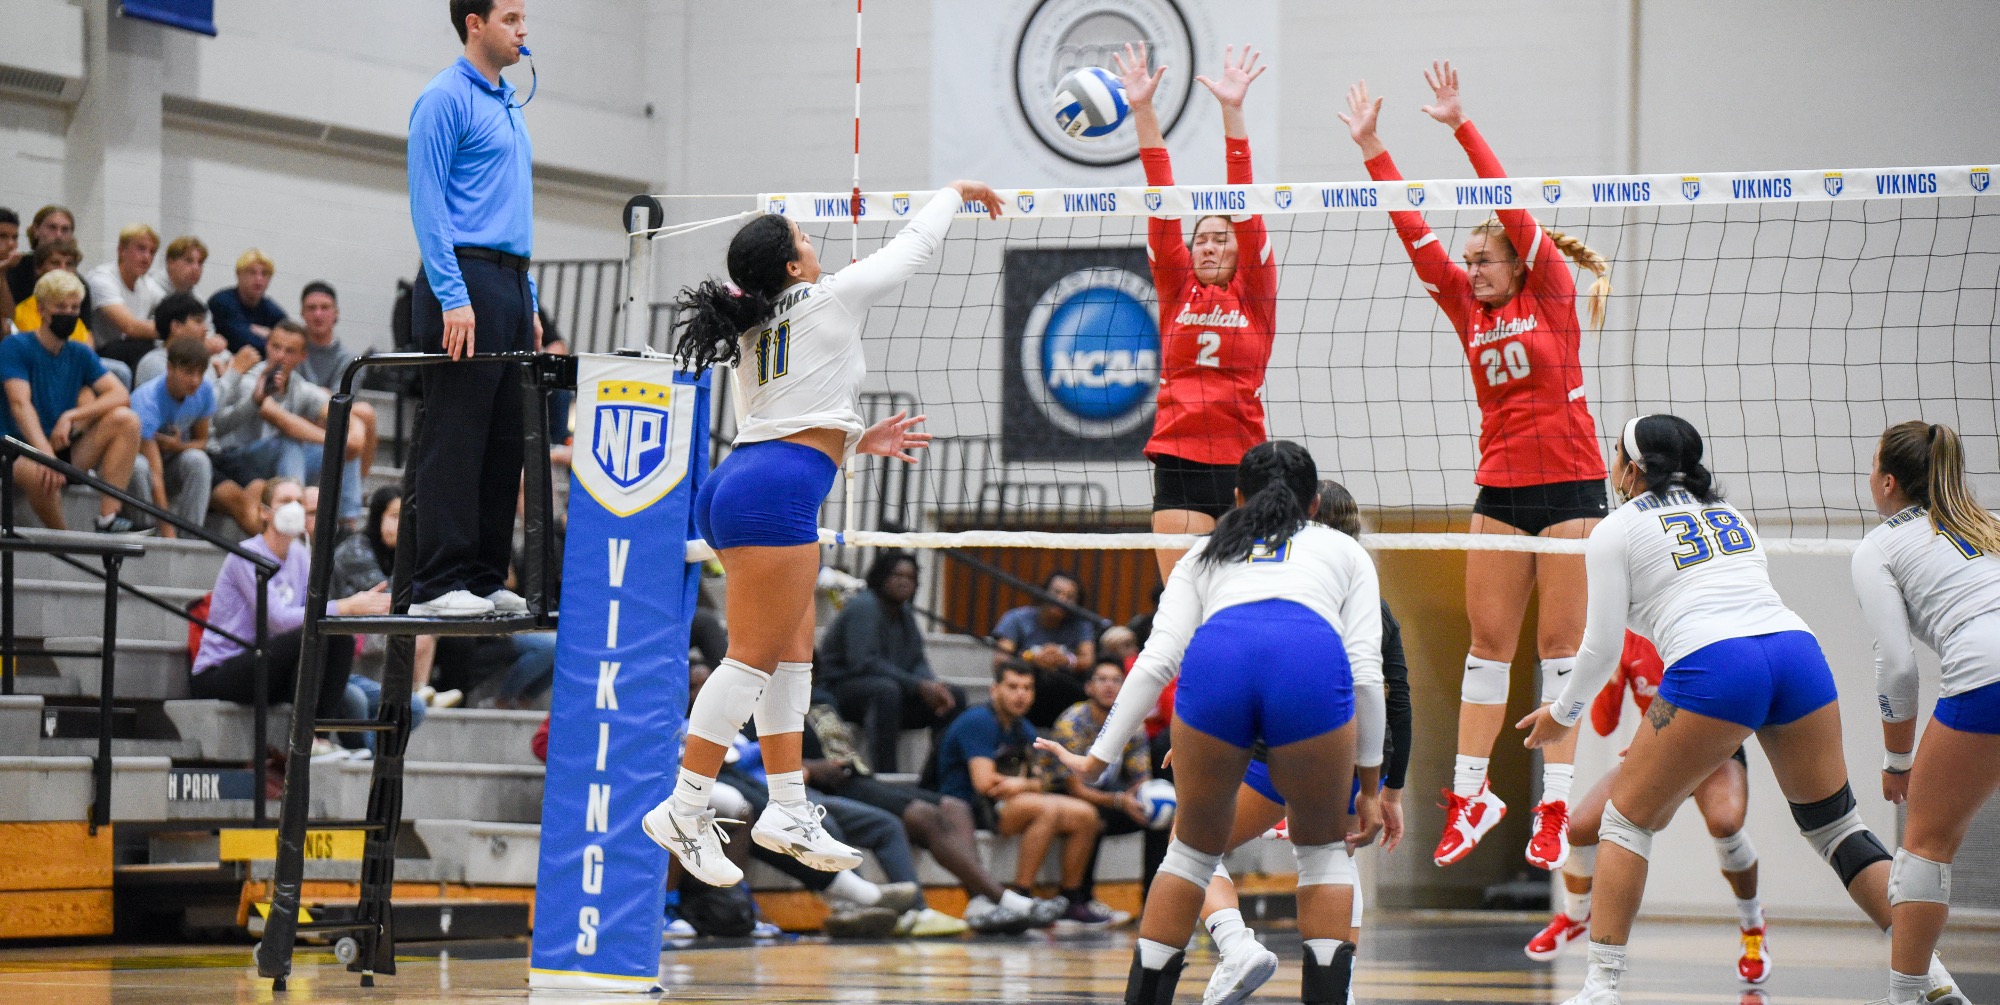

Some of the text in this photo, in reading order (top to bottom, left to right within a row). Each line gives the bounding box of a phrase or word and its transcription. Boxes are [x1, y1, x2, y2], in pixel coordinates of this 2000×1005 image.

[893, 197, 909, 214] NP
[1018, 195, 1034, 212] NP
[1064, 193, 1116, 212] VIKINGS
[1145, 192, 1161, 210] NP
[1192, 191, 1245, 210] VIKINGS
[1275, 190, 1291, 208] NP
[1322, 188, 1377, 207] VIKINGS
[1408, 188, 1424, 205] NP
[1456, 185, 1512, 205] VIKINGS
[1544, 185, 1560, 203] NP
[1592, 182, 1650, 202] VIKINGS
[1682, 182, 1700, 200] NP
[1732, 178, 1792, 198] VIKINGS
[1825, 178, 1842, 196] NP
[1876, 173, 1937, 194] VIKINGS
[1970, 173, 1989, 191] NP
[756, 319, 790, 386] 11
[1048, 352, 1158, 389] NCAA
[1195, 332, 1221, 368] 2
[1480, 341, 1531, 387] 20
[596, 408, 665, 482] NP
[1659, 508, 1756, 571] 38
[576, 538, 630, 957] VIKINGS
[183, 774, 220, 801] PARK
